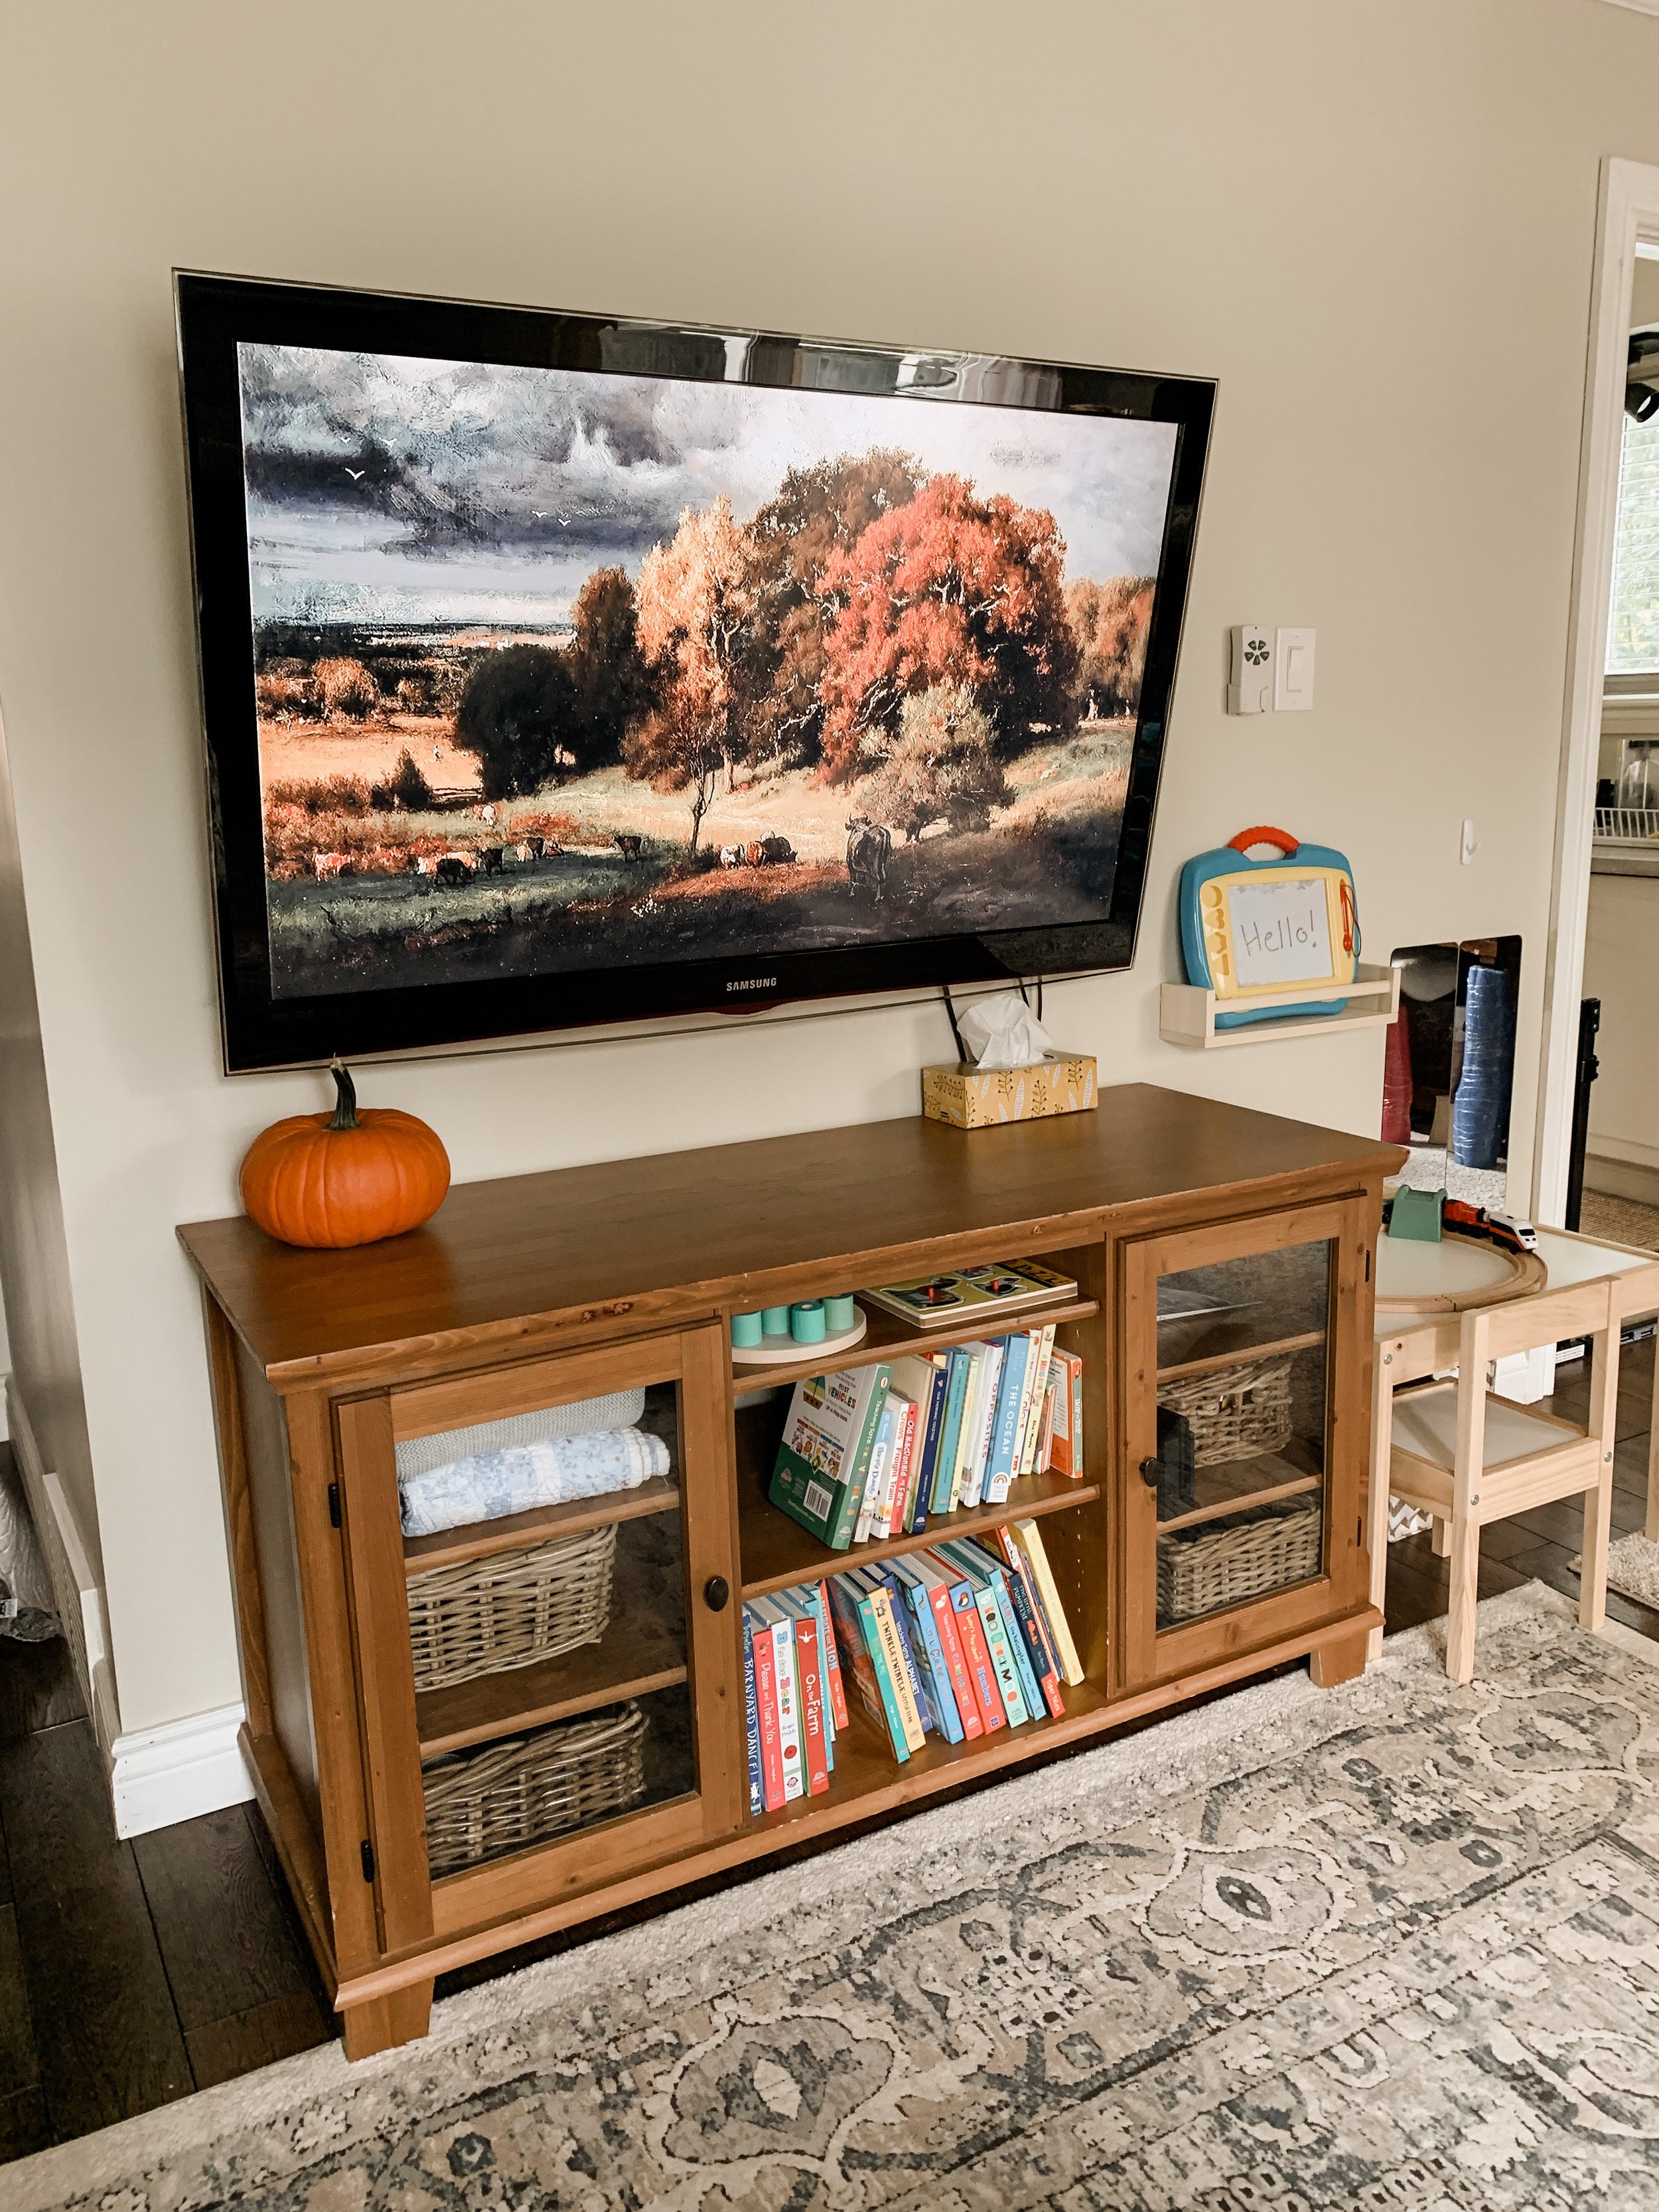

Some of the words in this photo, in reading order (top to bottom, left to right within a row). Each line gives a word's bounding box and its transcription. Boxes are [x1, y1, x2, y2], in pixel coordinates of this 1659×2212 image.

[1240, 909, 1317, 956] Hello!
[726, 978, 776, 992] SAMSUNG
[828, 1384, 857, 1410] VEHICLES
[1008, 1384, 1019, 1407] THE
[869, 1400, 882, 1429] Teaching
[897, 1411, 908, 1439] Crews
[905, 1420, 915, 1434] Old
[981, 1382, 998, 1459] OPPOSITES
[1001, 1410, 1015, 1455] OCEAN
[891, 1447, 902, 1479] Freight
[900, 1433, 913, 1477] MacDonald
[887, 1479, 897, 1501] Train
[896, 1487, 906, 1508] Farm
[1013, 1586, 1028, 1621] PUMPKINS
[776, 1631, 788, 1645] B
[1012, 1633, 1026, 1666] helicopter
[826, 1645, 839, 1671] LION
[745, 1658, 755, 1726] BARNYARD
[760, 1662, 771, 1692] Please
[805, 1673, 816, 1693] On
[904, 1658, 920, 1696] ALPHABET
[780, 1676, 791, 1714] Bear
[764, 1700, 774, 1730] Thank
[807, 1699, 823, 1736] Farm
[766, 1729, 776, 1745] You
